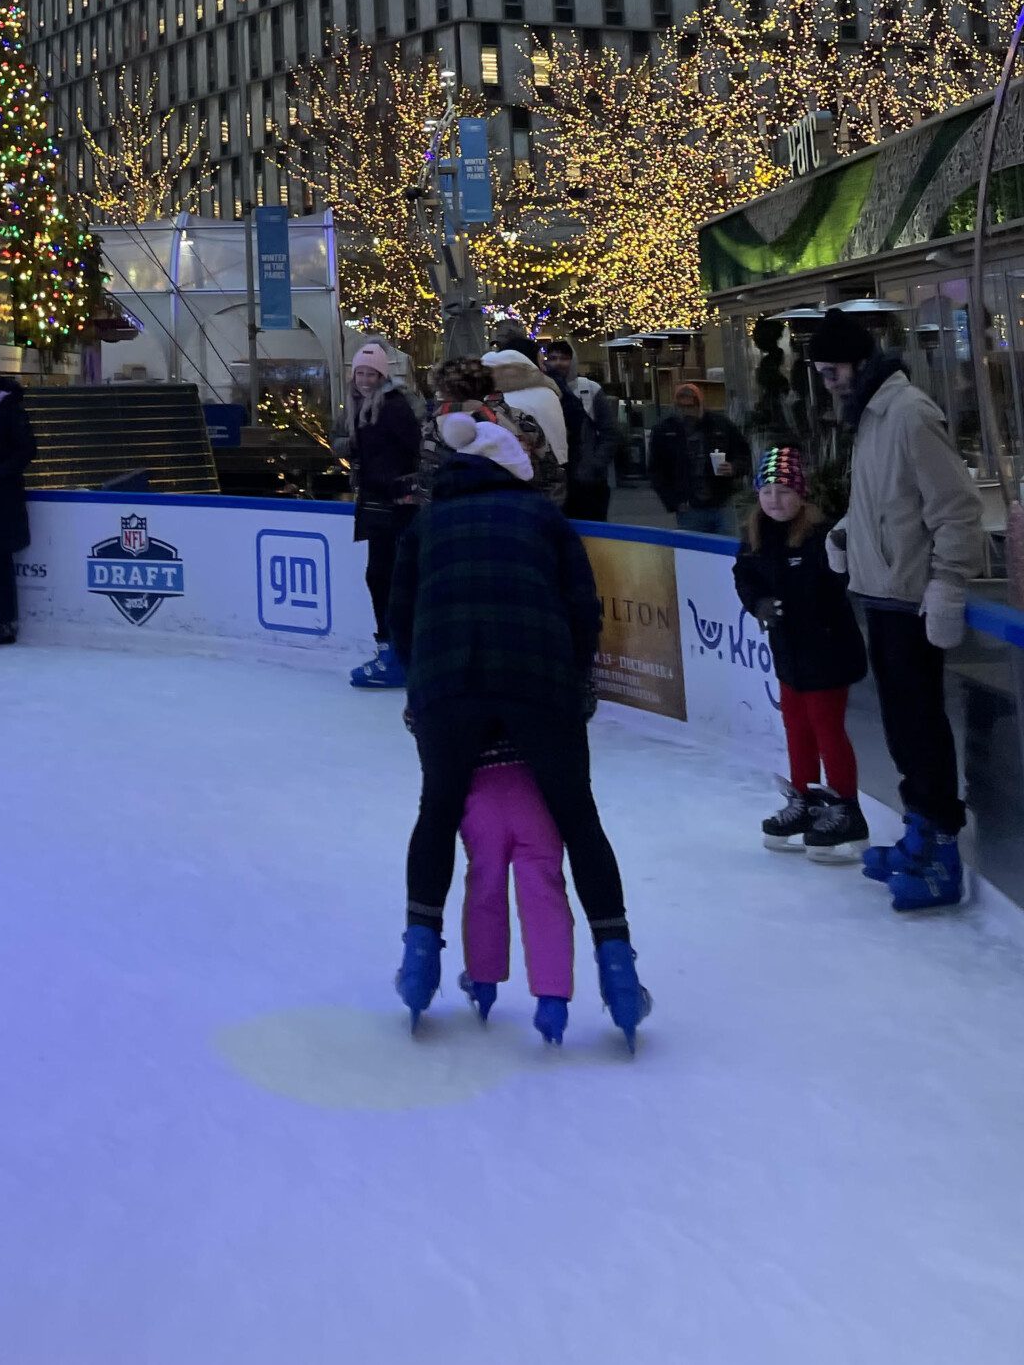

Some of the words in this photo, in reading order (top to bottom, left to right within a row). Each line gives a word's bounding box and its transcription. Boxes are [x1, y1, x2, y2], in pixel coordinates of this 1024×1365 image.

[464, 158, 487, 166] WINTER
[466, 172, 486, 180] PARKS
[260, 254, 287, 262] WINTER
[263, 271, 285, 280] PARKS
[123, 530, 144, 548] NFL
[15, 563, 47, 578] ress
[93, 565, 177, 588] DRAFT
[270, 555, 316, 605] gm
